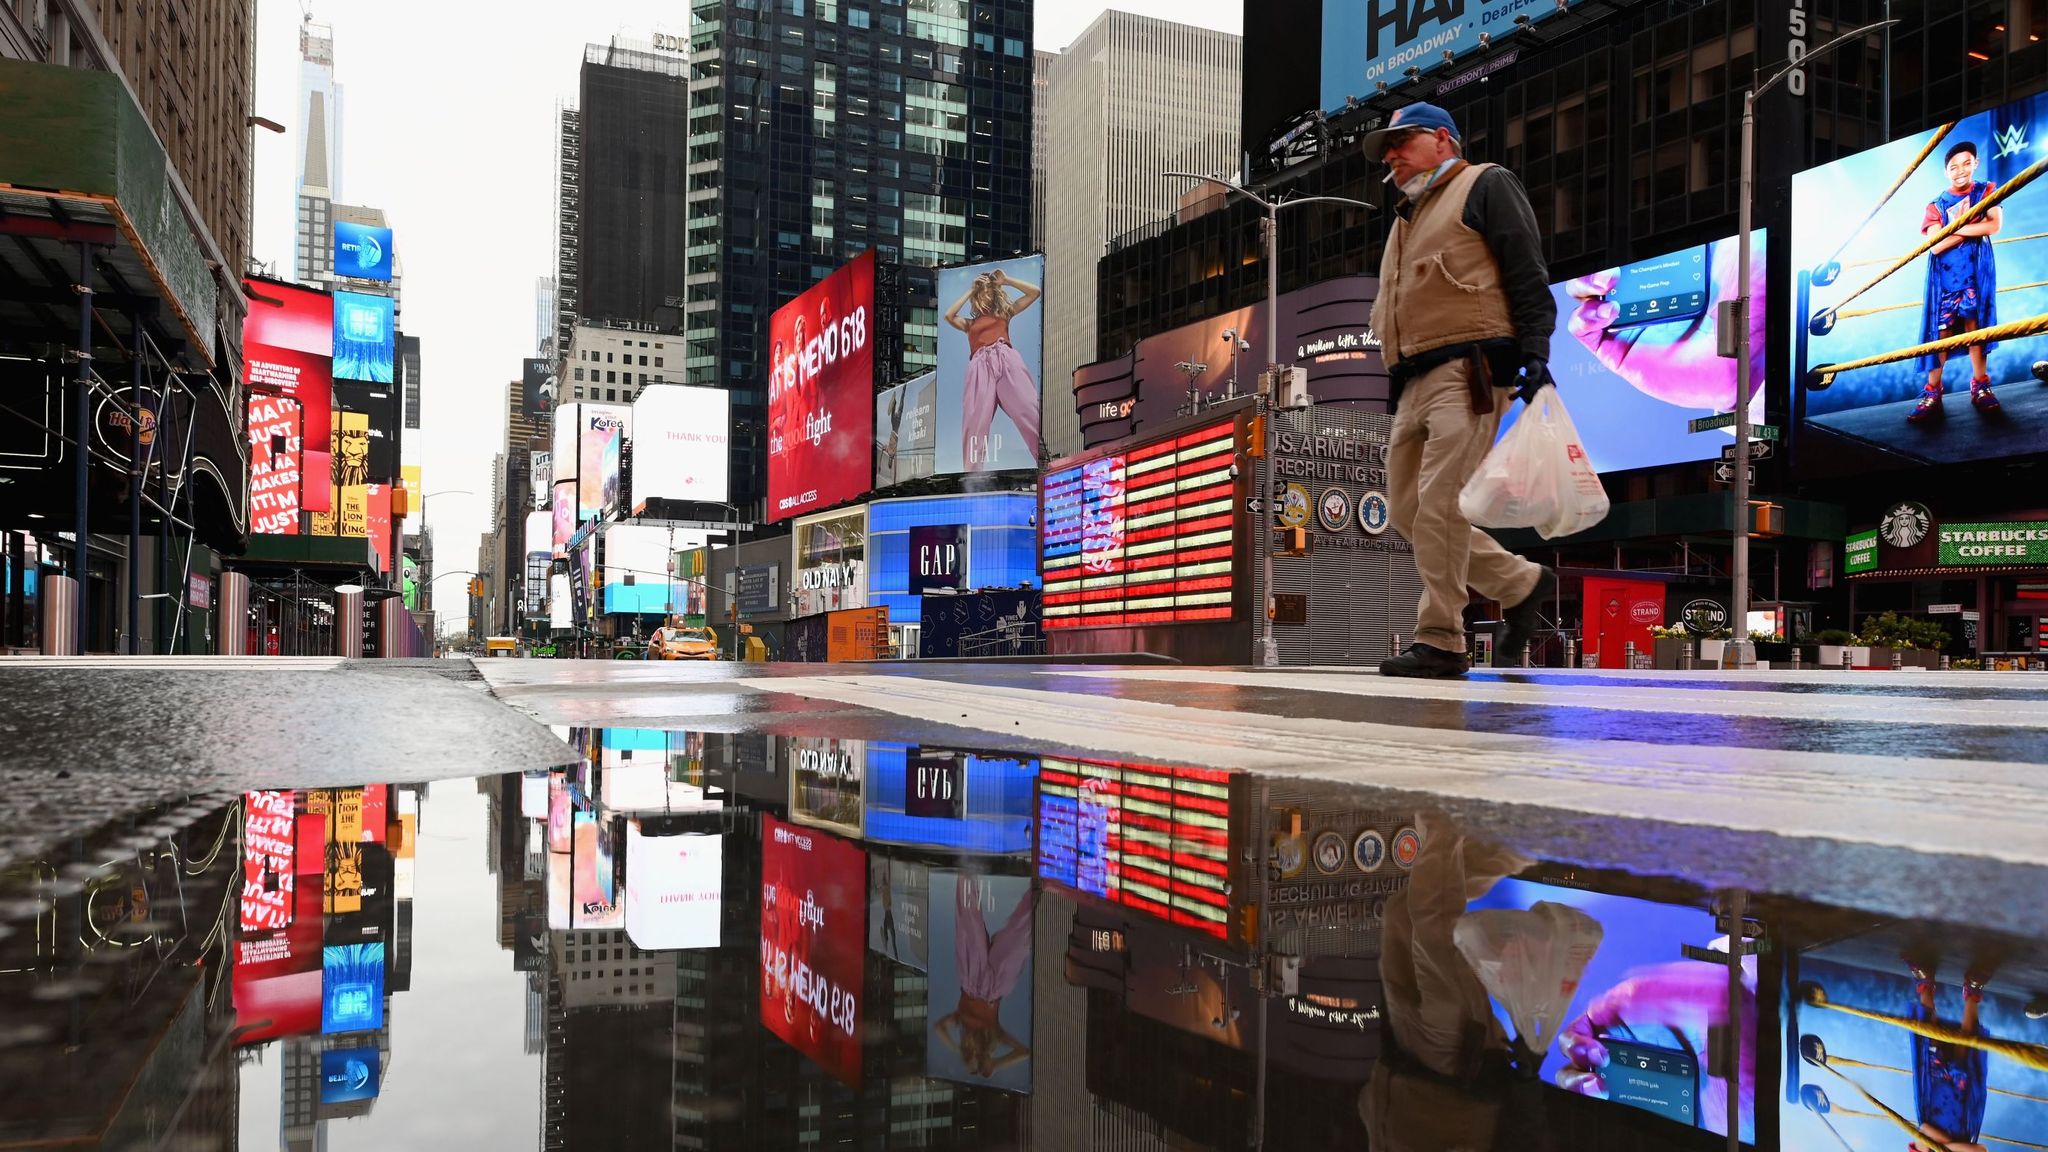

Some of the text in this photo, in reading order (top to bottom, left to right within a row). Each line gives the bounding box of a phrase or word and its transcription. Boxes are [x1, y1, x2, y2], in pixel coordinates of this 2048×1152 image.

[1366, 24, 1462, 80] ON BROADWAY
[799, 323, 838, 387] MEMO
[841, 305, 866, 358] 618
[1306, 338, 1335, 354] million
[1337, 333, 1358, 349] little
[1099, 402, 1118, 418] life
[591, 417, 624, 432] Korea
[770, 430, 783, 455] the
[805, 406, 832, 446] fight
[911, 418, 923, 430] the
[1697, 415, 1734, 430] Broadway
[248, 421, 293, 444] JUST
[666, 431, 726, 444] THANK YOU
[1763, 427, 1771, 437] 43
[969, 432, 1003, 464] GAP
[1300, 435, 1365, 461] ARMED
[1274, 457, 1366, 483] RECRUITNG
[345, 503, 360, 511] THE
[779, 489, 817, 510] CBS ALL ACCESS
[254, 508, 300, 533] JUST
[343, 511, 363, 522] LION
[341, 523, 366, 535] KING
[1942, 529, 2048, 543] STARBUCKS
[1846, 535, 1877, 552] STARBUCKS
[1959, 545, 2027, 557] COFFEE
[920, 544, 955, 576] GAP
[1850, 552, 1871, 565] COFFEE
[803, 569, 821, 589] OLD
[1632, 607, 1659, 616] STRAND
